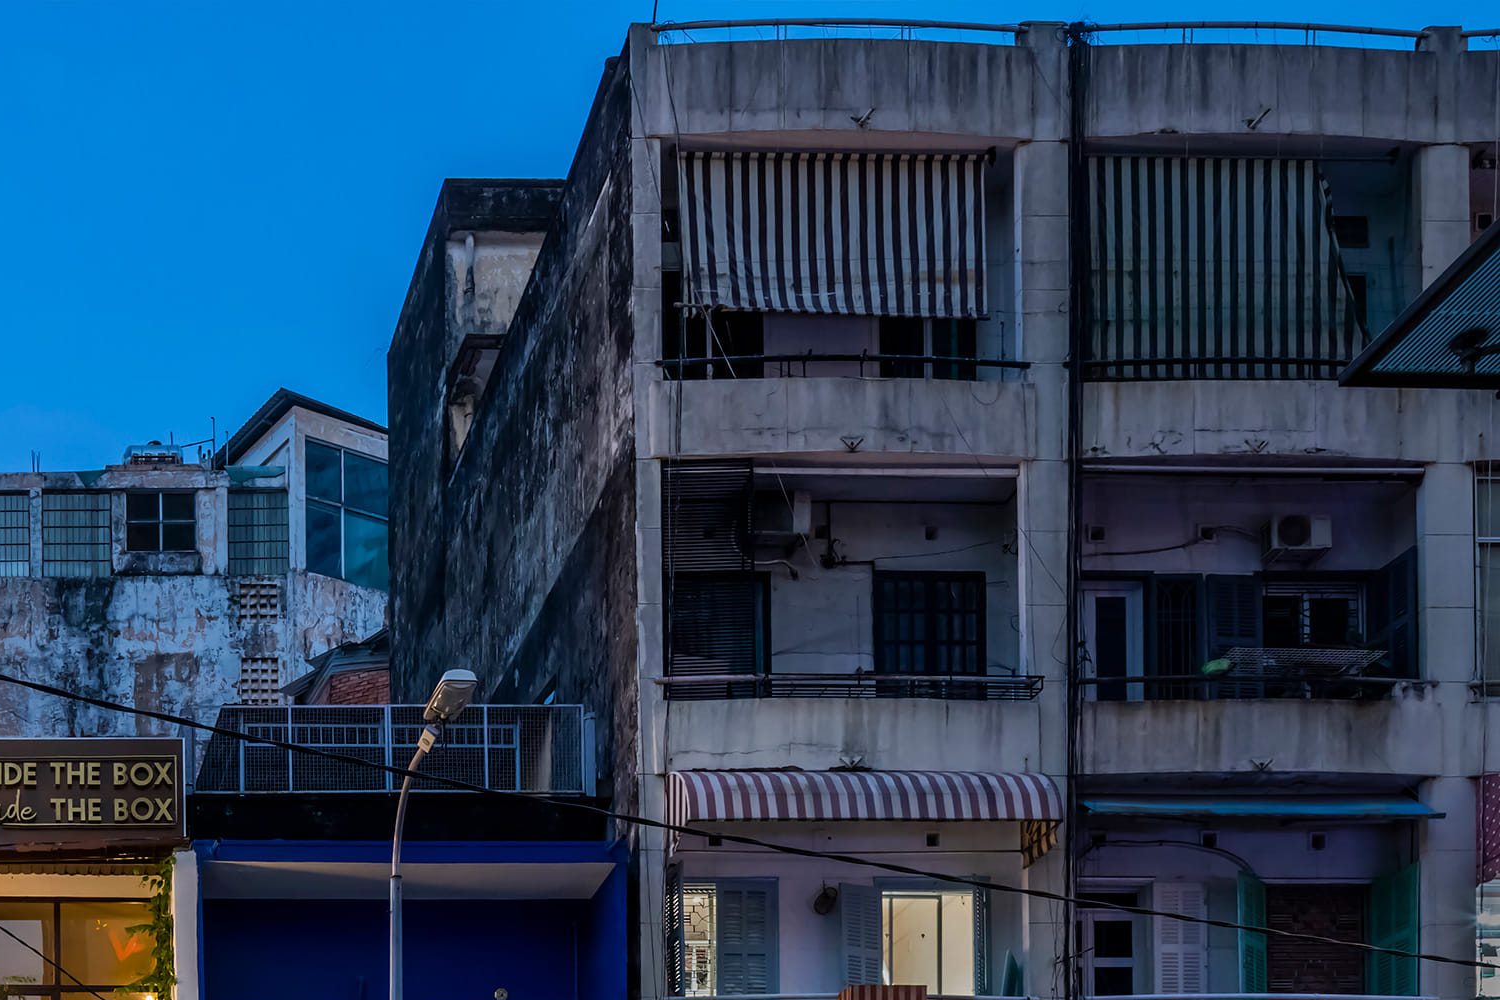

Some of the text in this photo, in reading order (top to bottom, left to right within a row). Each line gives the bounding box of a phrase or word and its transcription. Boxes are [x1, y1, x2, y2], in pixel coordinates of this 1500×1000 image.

[50, 761, 100, 786] THE
[113, 761, 173, 786] BOX
[50, 797, 100, 822] THE
[113, 797, 173, 822] BOX
